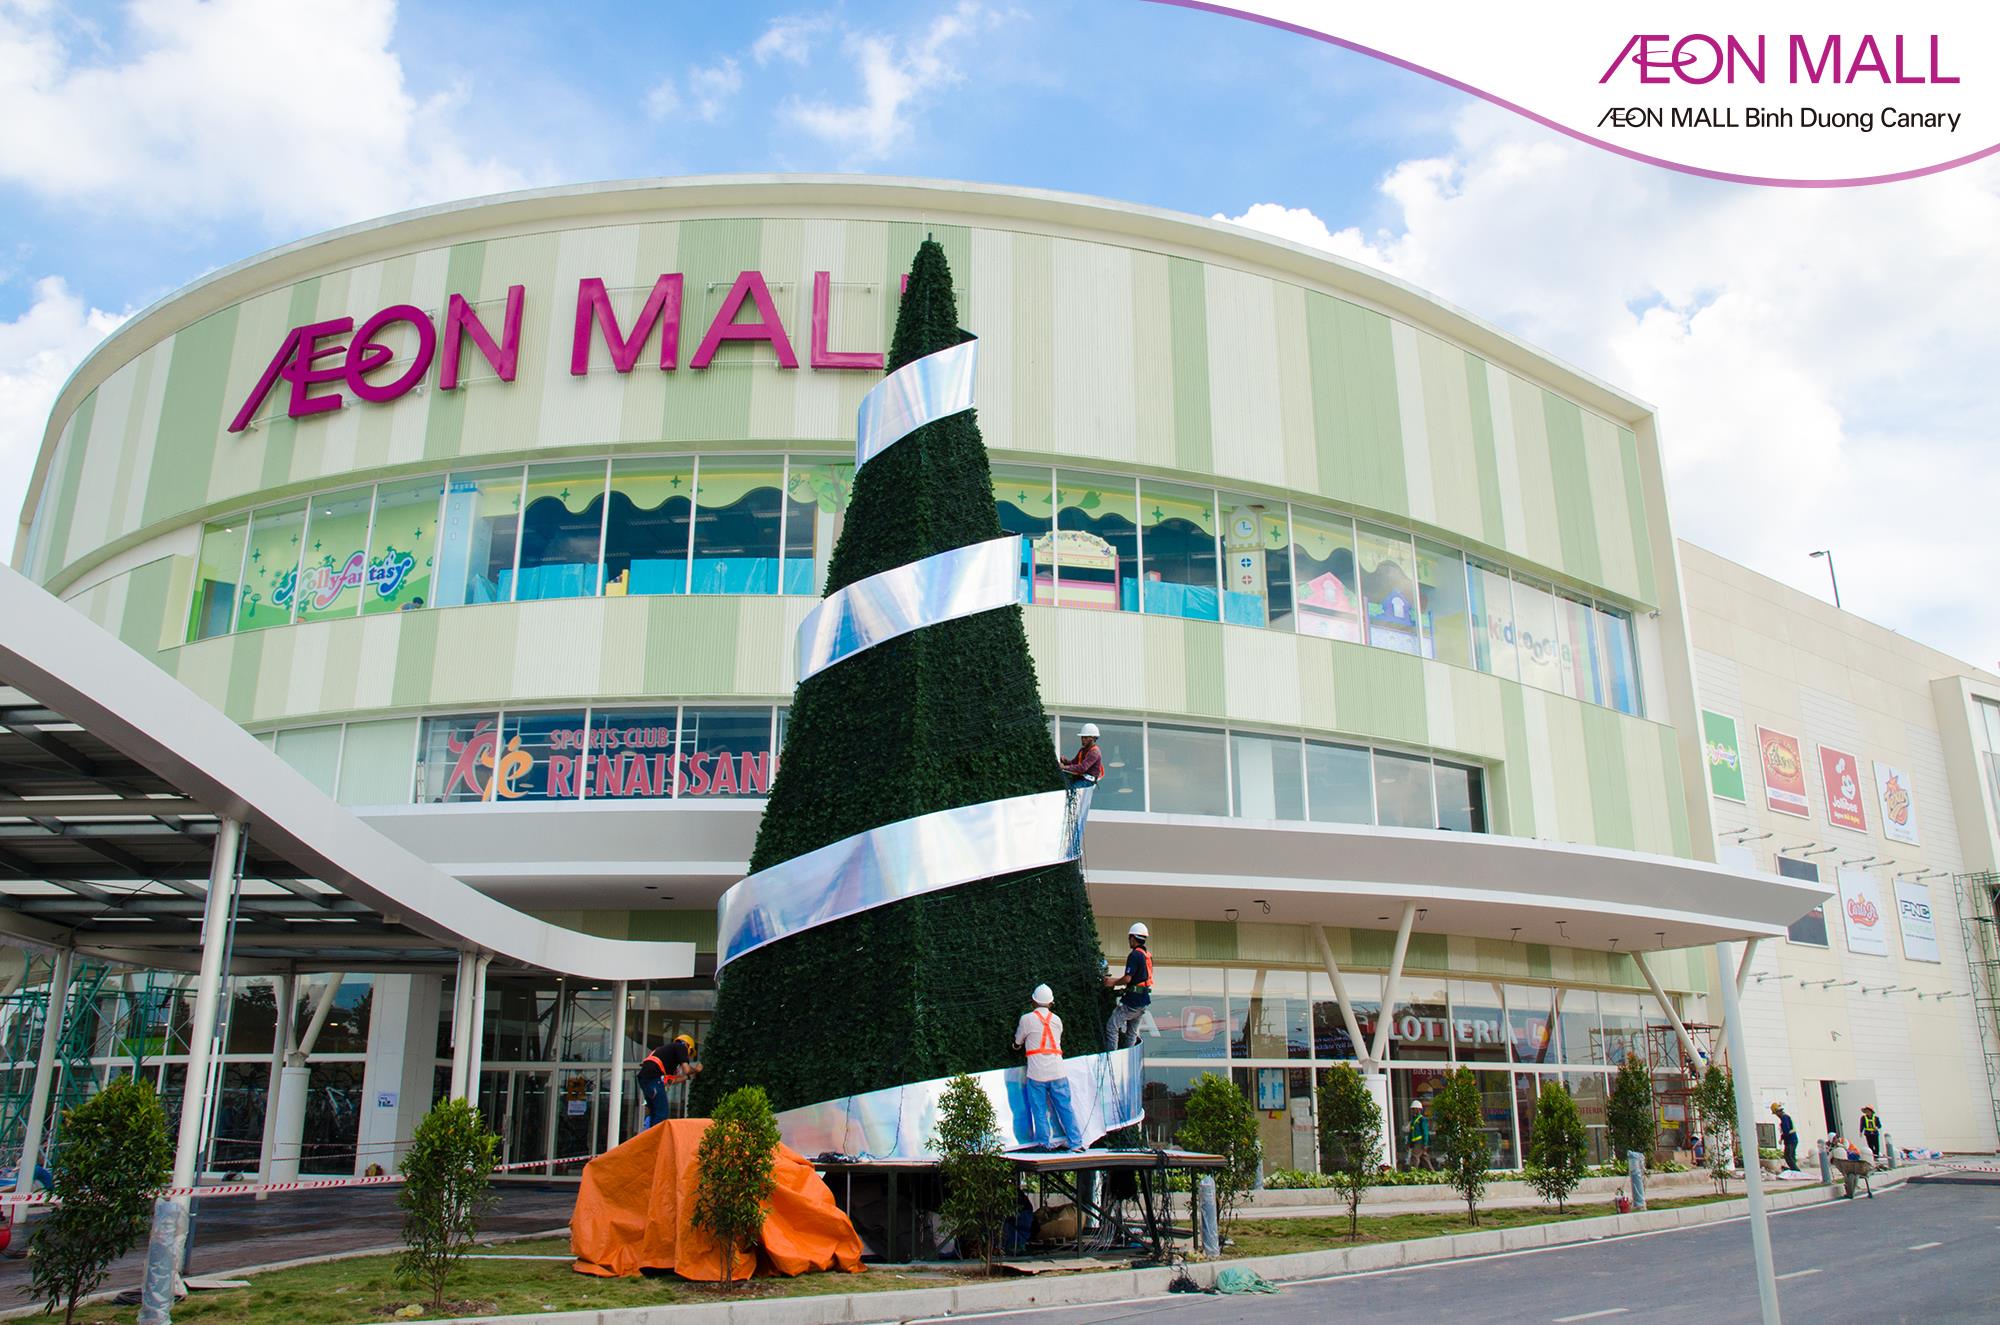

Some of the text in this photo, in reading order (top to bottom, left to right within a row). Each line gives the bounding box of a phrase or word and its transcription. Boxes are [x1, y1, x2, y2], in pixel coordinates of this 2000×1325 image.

[570, 271, 908, 376] MAL
[550, 727, 669, 750] SPORTS CLUB
[547, 751, 781, 797] RENAISSAN
[1388, 1015, 1518, 1045] LOTTERIA
